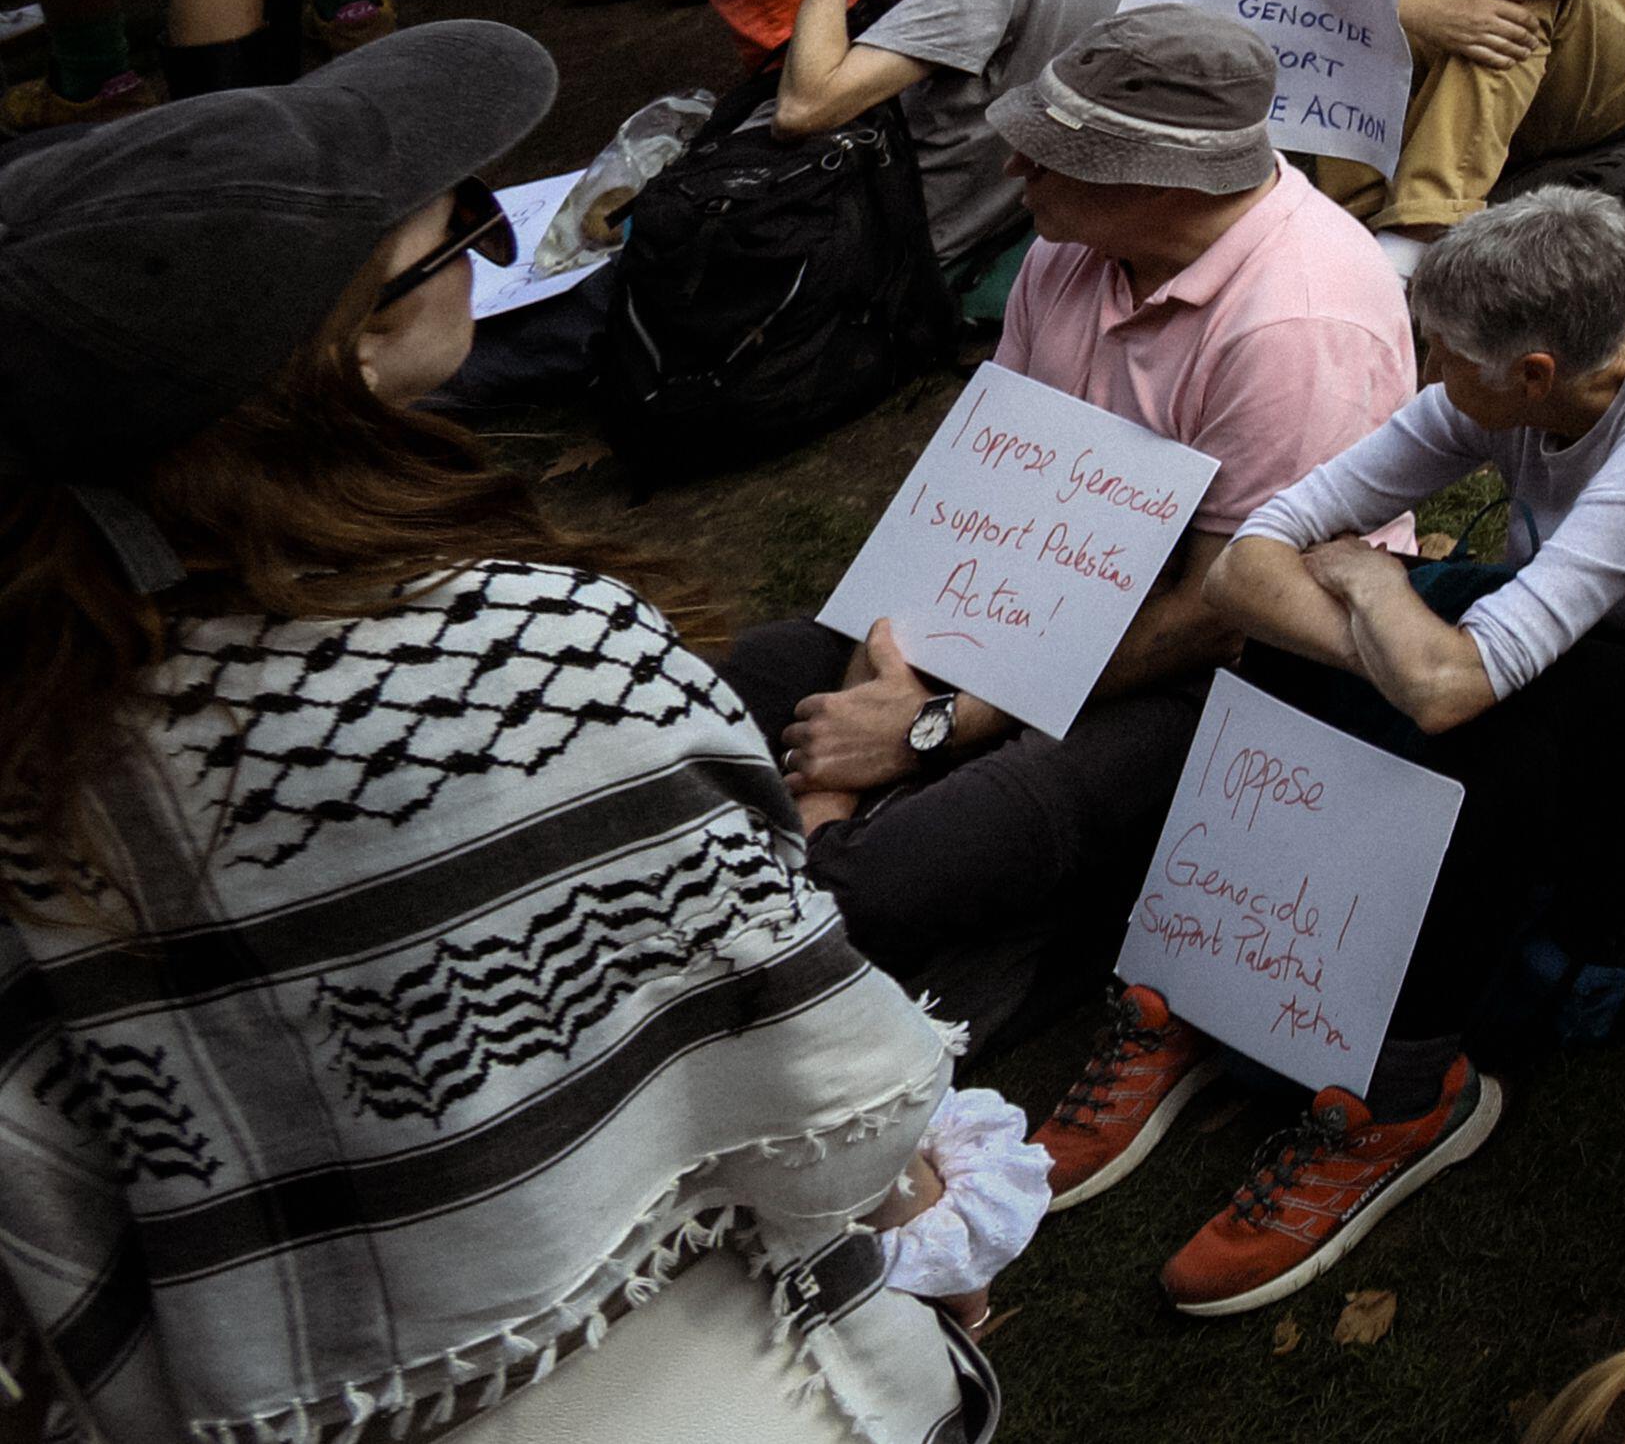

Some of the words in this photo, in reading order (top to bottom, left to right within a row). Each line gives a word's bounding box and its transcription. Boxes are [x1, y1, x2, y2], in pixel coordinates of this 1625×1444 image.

[1301, 100, 1386, 144] ACTION
[973, 429, 1057, 476] oppose
[929, 499, 1036, 555] support
[1223, 749, 1326, 831] oppose
